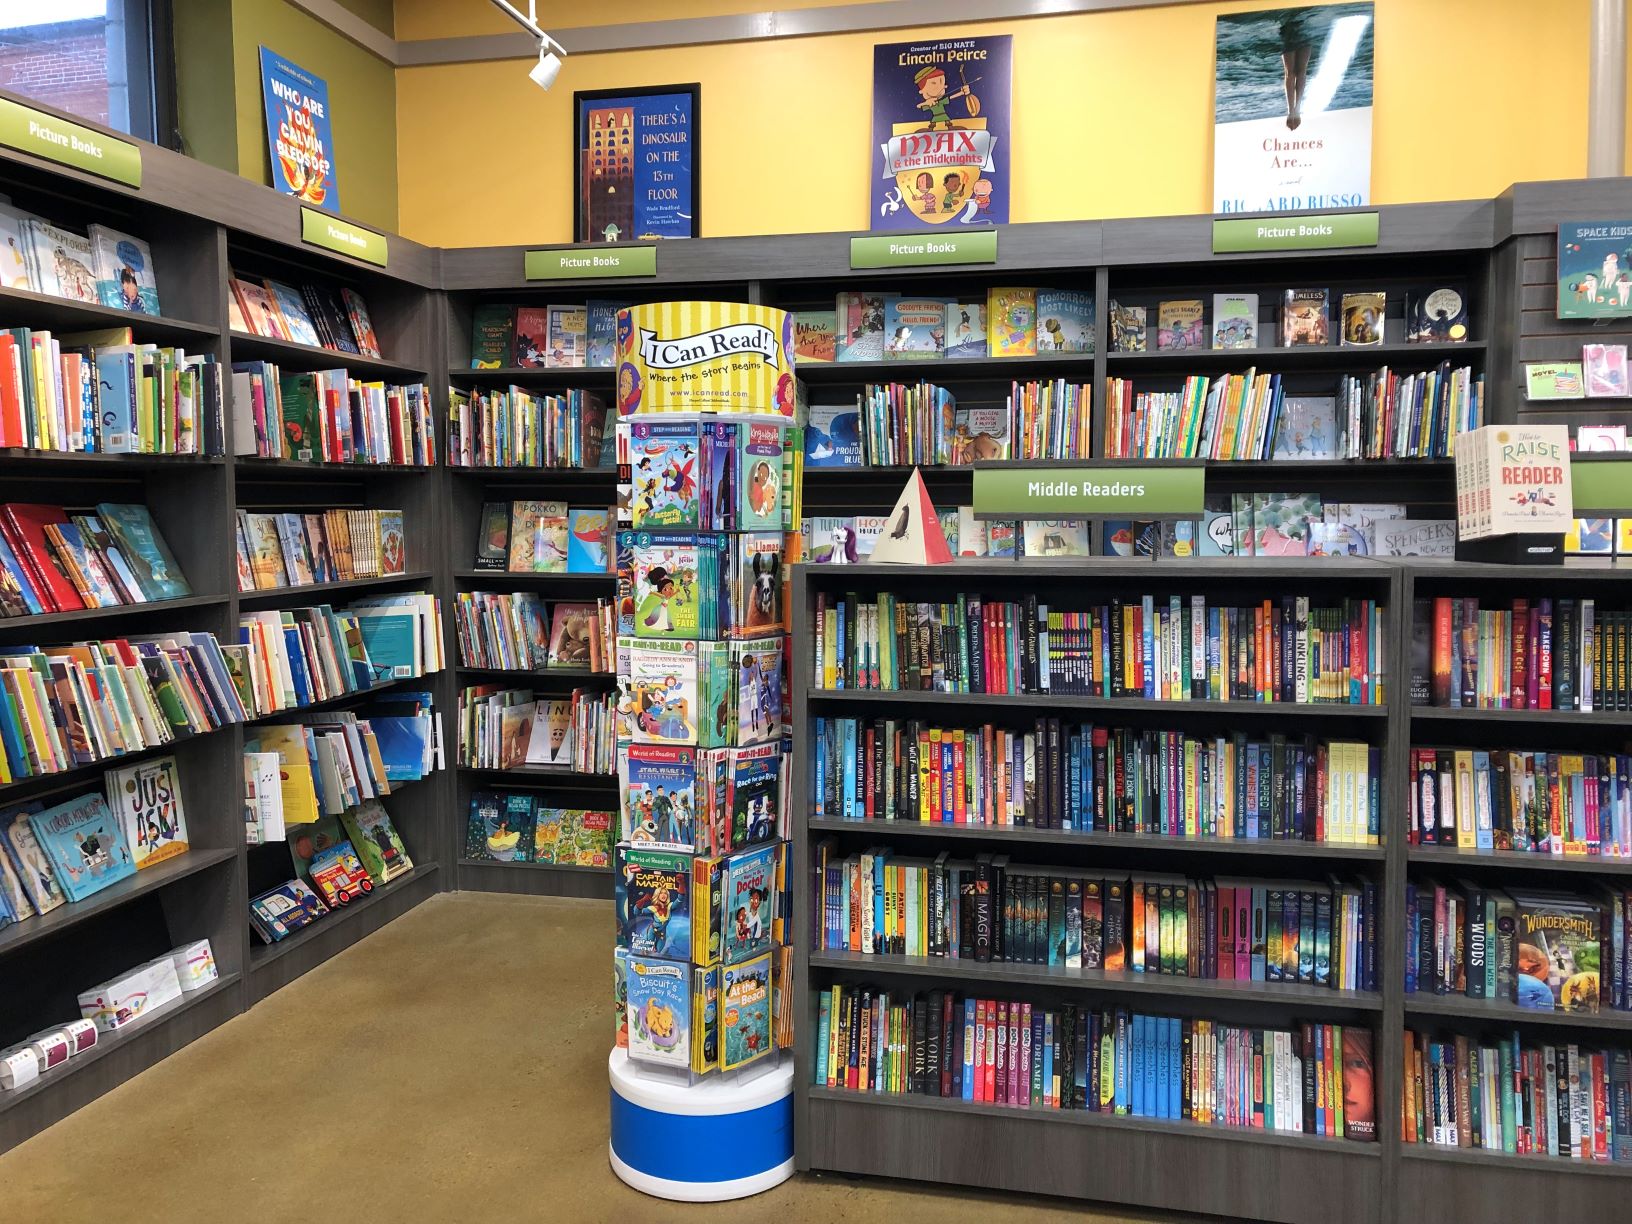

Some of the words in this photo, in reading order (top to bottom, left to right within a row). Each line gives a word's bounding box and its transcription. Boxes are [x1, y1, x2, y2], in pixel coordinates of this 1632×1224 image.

[939, 42, 952, 50] BIG
[954, 41, 975, 49] NATE
[899, 52, 944, 66] Lincoln
[947, 49, 987, 62] Peirce
[271, 78, 301, 105] WHO
[303, 96, 324, 118] ARE
[641, 114, 677, 126] THERE'S
[679, 113, 686, 123] A
[29, 120, 69, 147] Picture
[71, 136, 103, 159] Books
[280, 123, 323, 154] CALVIN
[643, 132, 687, 144] DINOSAUR
[900, 131, 977, 157] MAX
[1263, 137, 1324, 152] Chances
[276, 139, 331, 175] BLEDSOE?
[646, 152, 660, 163] ON
[663, 151, 679, 162] THE
[894, 159, 902, 168] &
[904, 156, 921, 167] the
[923, 154, 983, 165] Midknights
[1270, 155, 1312, 169] Are...
[653, 171, 673, 181] 13TH
[648, 188, 678, 200] FLOOR
[1223, 198, 1302, 213] RICARD
[1308, 193, 1362, 208] RUSSO
[1257, 226, 1296, 238] Picture
[1299, 225, 1332, 236] Books
[1577, 228, 1608, 238] SPACE
[1610, 226, 1632, 236] KIDS
[890, 244, 924, 254] Picture
[927, 243, 956, 253] Books
[560, 257, 591, 268] Picture
[594, 256, 619, 266] Books
[1039, 294, 1093, 305] TOMORROW
[1293, 292, 1323, 300] TIMELESS
[1040, 304, 1062, 314] MOST
[1064, 305, 1093, 317] LIKELY
[796, 322, 827, 336] Where
[652, 344, 657, 364] I
[662, 344, 706, 364] Can
[708, 328, 770, 354] Read!
[800, 336, 816, 346] Are
[649, 373, 677, 382] Where
[681, 373, 698, 383] the
[702, 366, 729, 378] Story
[732, 362, 761, 371] Begins
[669, 390, 748, 398] www.icanread.com
[640, 427, 646, 436] 3
[1503, 442, 1560, 462] RAISE
[1502, 467, 1563, 485] READER
[1028, 482, 1077, 497] Middle
[1083, 482, 1144, 497] Readers
[523, 505, 557, 513] POKKO
[626, 536, 632, 544] 2
[642, 536, 647, 544] 2
[720, 538, 724, 547] 2
[1385, 524, 1455, 549] SPENCER'S
[755, 540, 779, 552] Llamas
[1421, 545, 1438, 553] NEW
[676, 619, 695, 628] FAIR
[1144, 665, 1152, 682] ICE
[656, 750, 675, 758] Reading
[737, 777, 751, 788] Race
[766, 772, 777, 782] Ring
[132, 762, 175, 813] JUST
[1260, 767, 1270, 810] TRAPPED!
[137, 808, 179, 847] ASK!
[651, 857, 671, 865] Reading
[636, 880, 678, 889] MARVEL
[736, 875, 764, 895] Doctor
[875, 885, 882, 896] LU
[977, 904, 987, 946] MAGIC
[1522, 913, 1595, 940] WUNDERSMITH
[1472, 923, 1484, 966] WOODS
[640, 977, 678, 992] Biscuit's
[730, 985, 741, 997] At
[742, 980, 756, 994] the
[633, 989, 649, 997] Snow
[651, 988, 664, 997] Day
[666, 990, 682, 1002] Race
[742, 988, 766, 1005] Beach
[916, 1040, 925, 1075] YORK
[927, 1035, 938, 1075] YORK
[1134, 1038, 1143, 1083] Speechless
[1147, 1039, 1156, 1084] Speechless
[1159, 1040, 1168, 1086] Speechless
[1172, 1042, 1181, 1087] Speechless
[1580, 1093, 1588, 1106] SAVE
[1581, 1108, 1588, 1116] ME
